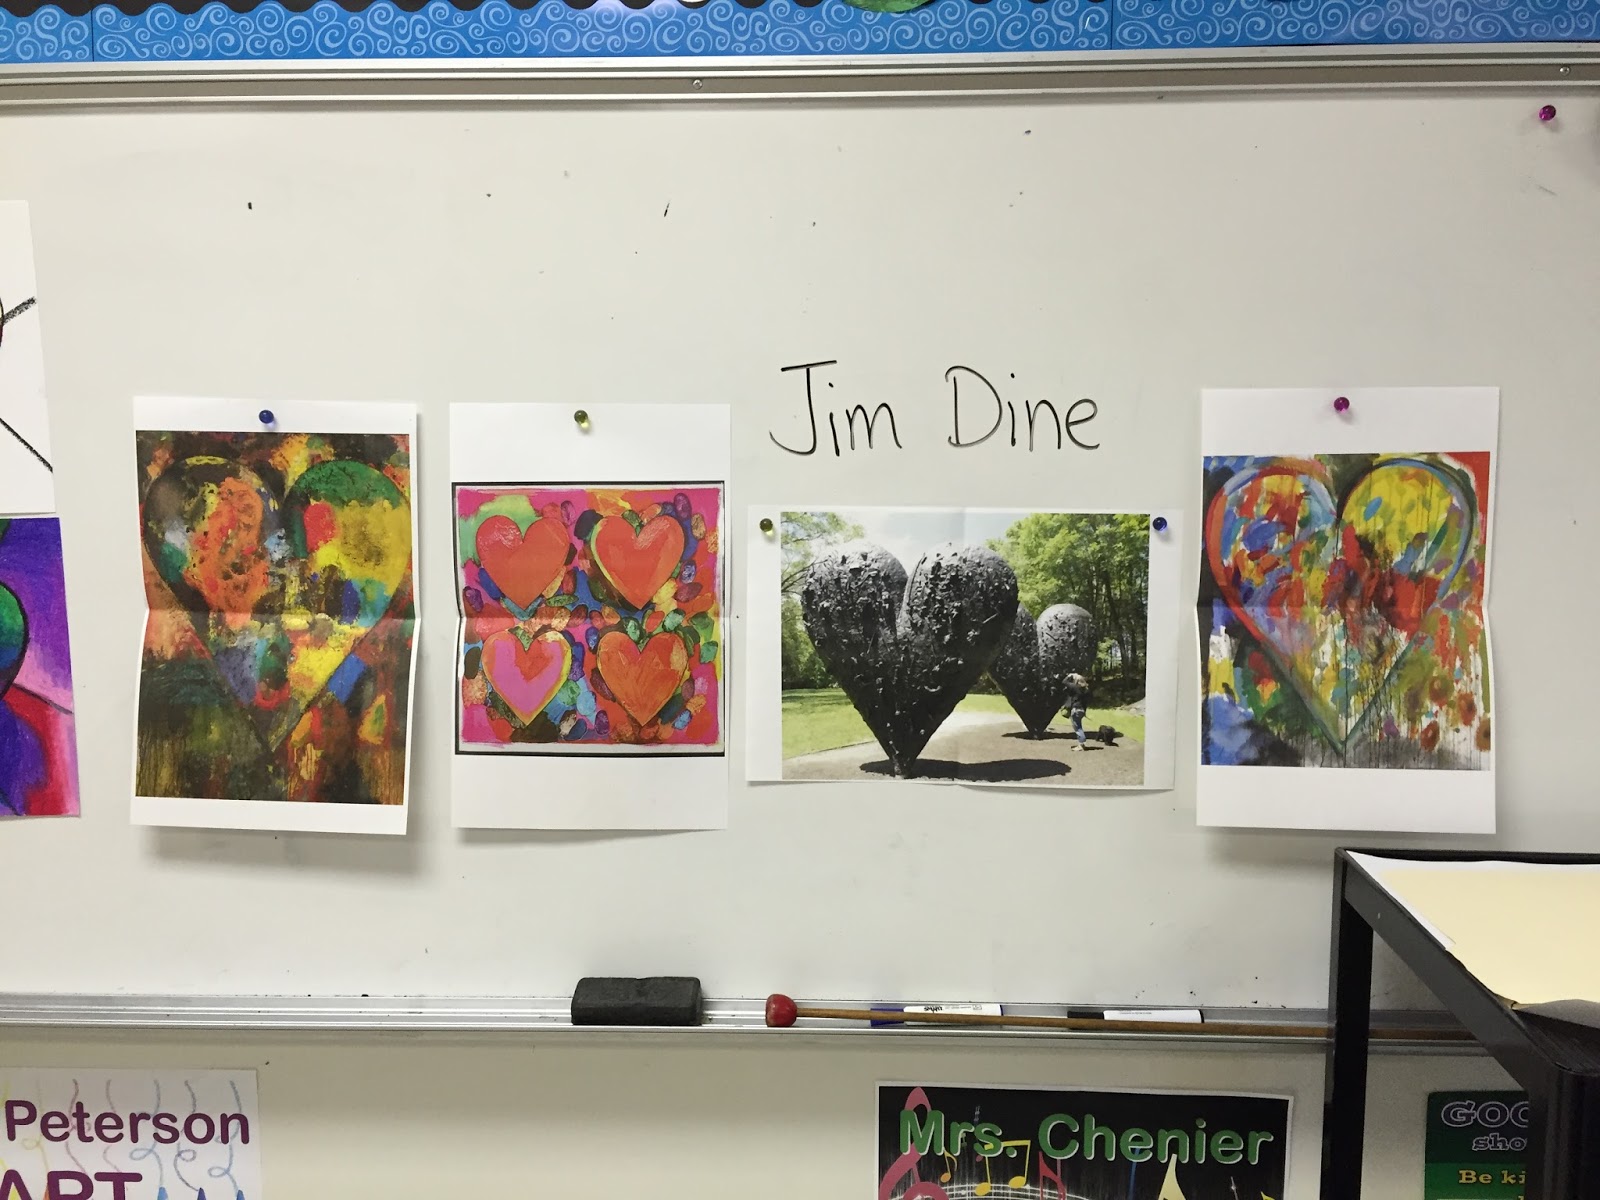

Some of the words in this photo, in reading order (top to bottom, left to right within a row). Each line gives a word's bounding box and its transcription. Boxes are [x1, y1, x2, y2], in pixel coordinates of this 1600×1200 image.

[769, 360, 902, 457] Jim
[945, 364, 1100, 452] Dine
[4, 1099, 250, 1145] Peterson
[899, 1109, 1018, 1159] Mrs.
[1038, 1113, 1275, 1165] Chenier
[1458, 1169, 1492, 1185] Be
